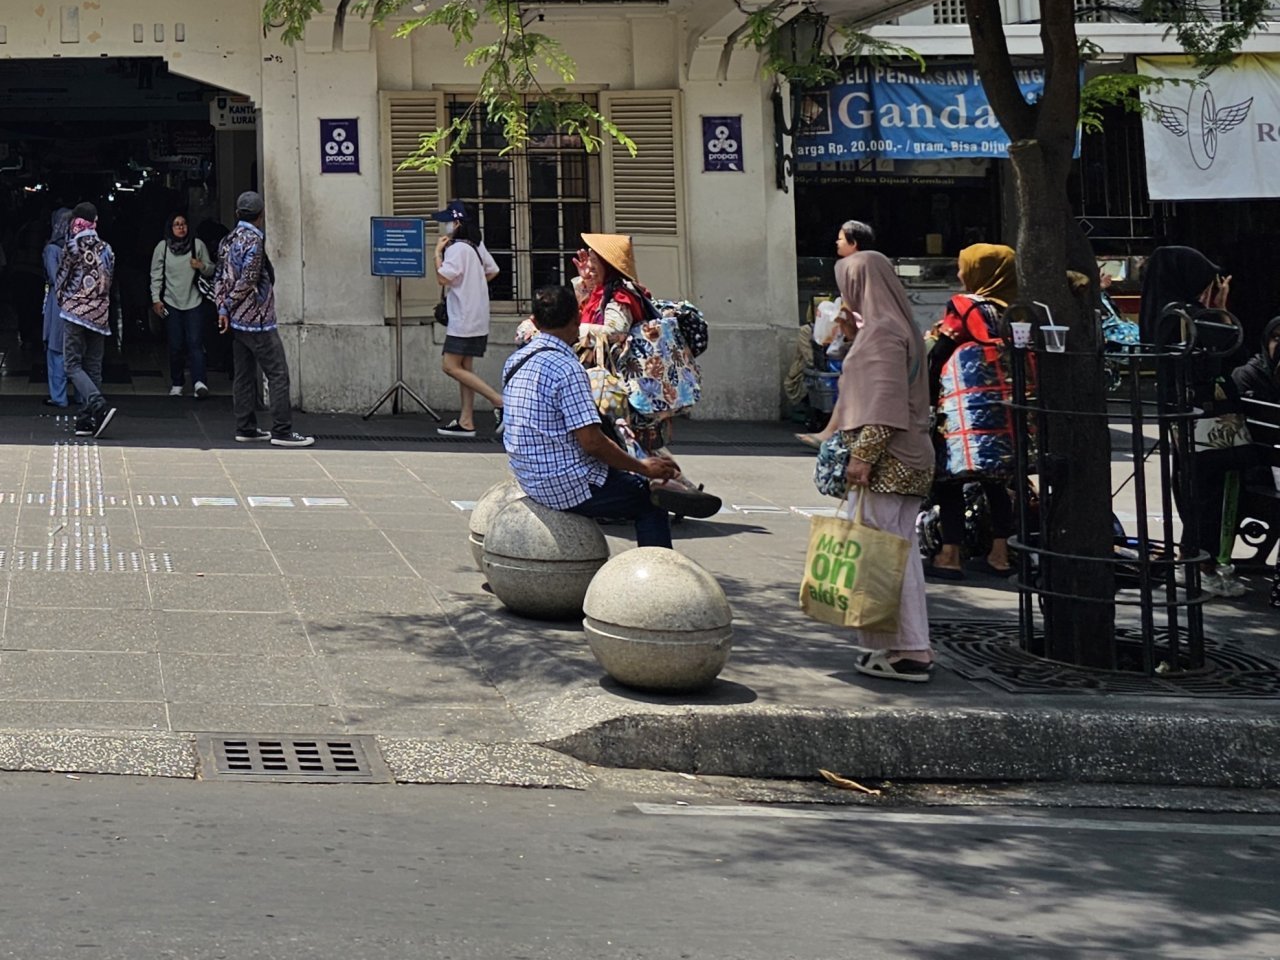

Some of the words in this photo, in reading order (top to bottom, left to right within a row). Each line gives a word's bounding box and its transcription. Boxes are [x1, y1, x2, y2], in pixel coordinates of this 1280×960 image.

[708, 153, 738, 161] propan
[797, 145, 825, 157] arga
[828, 143, 848, 155] Rp.
[850, 140, 903, 153] 20.000,-
[913, 142, 948, 154] gram,
[950, 141, 978, 152] Bisa
[815, 534, 862, 560] McD
[810, 553, 857, 589] on
[809, 582, 849, 611] ald's
